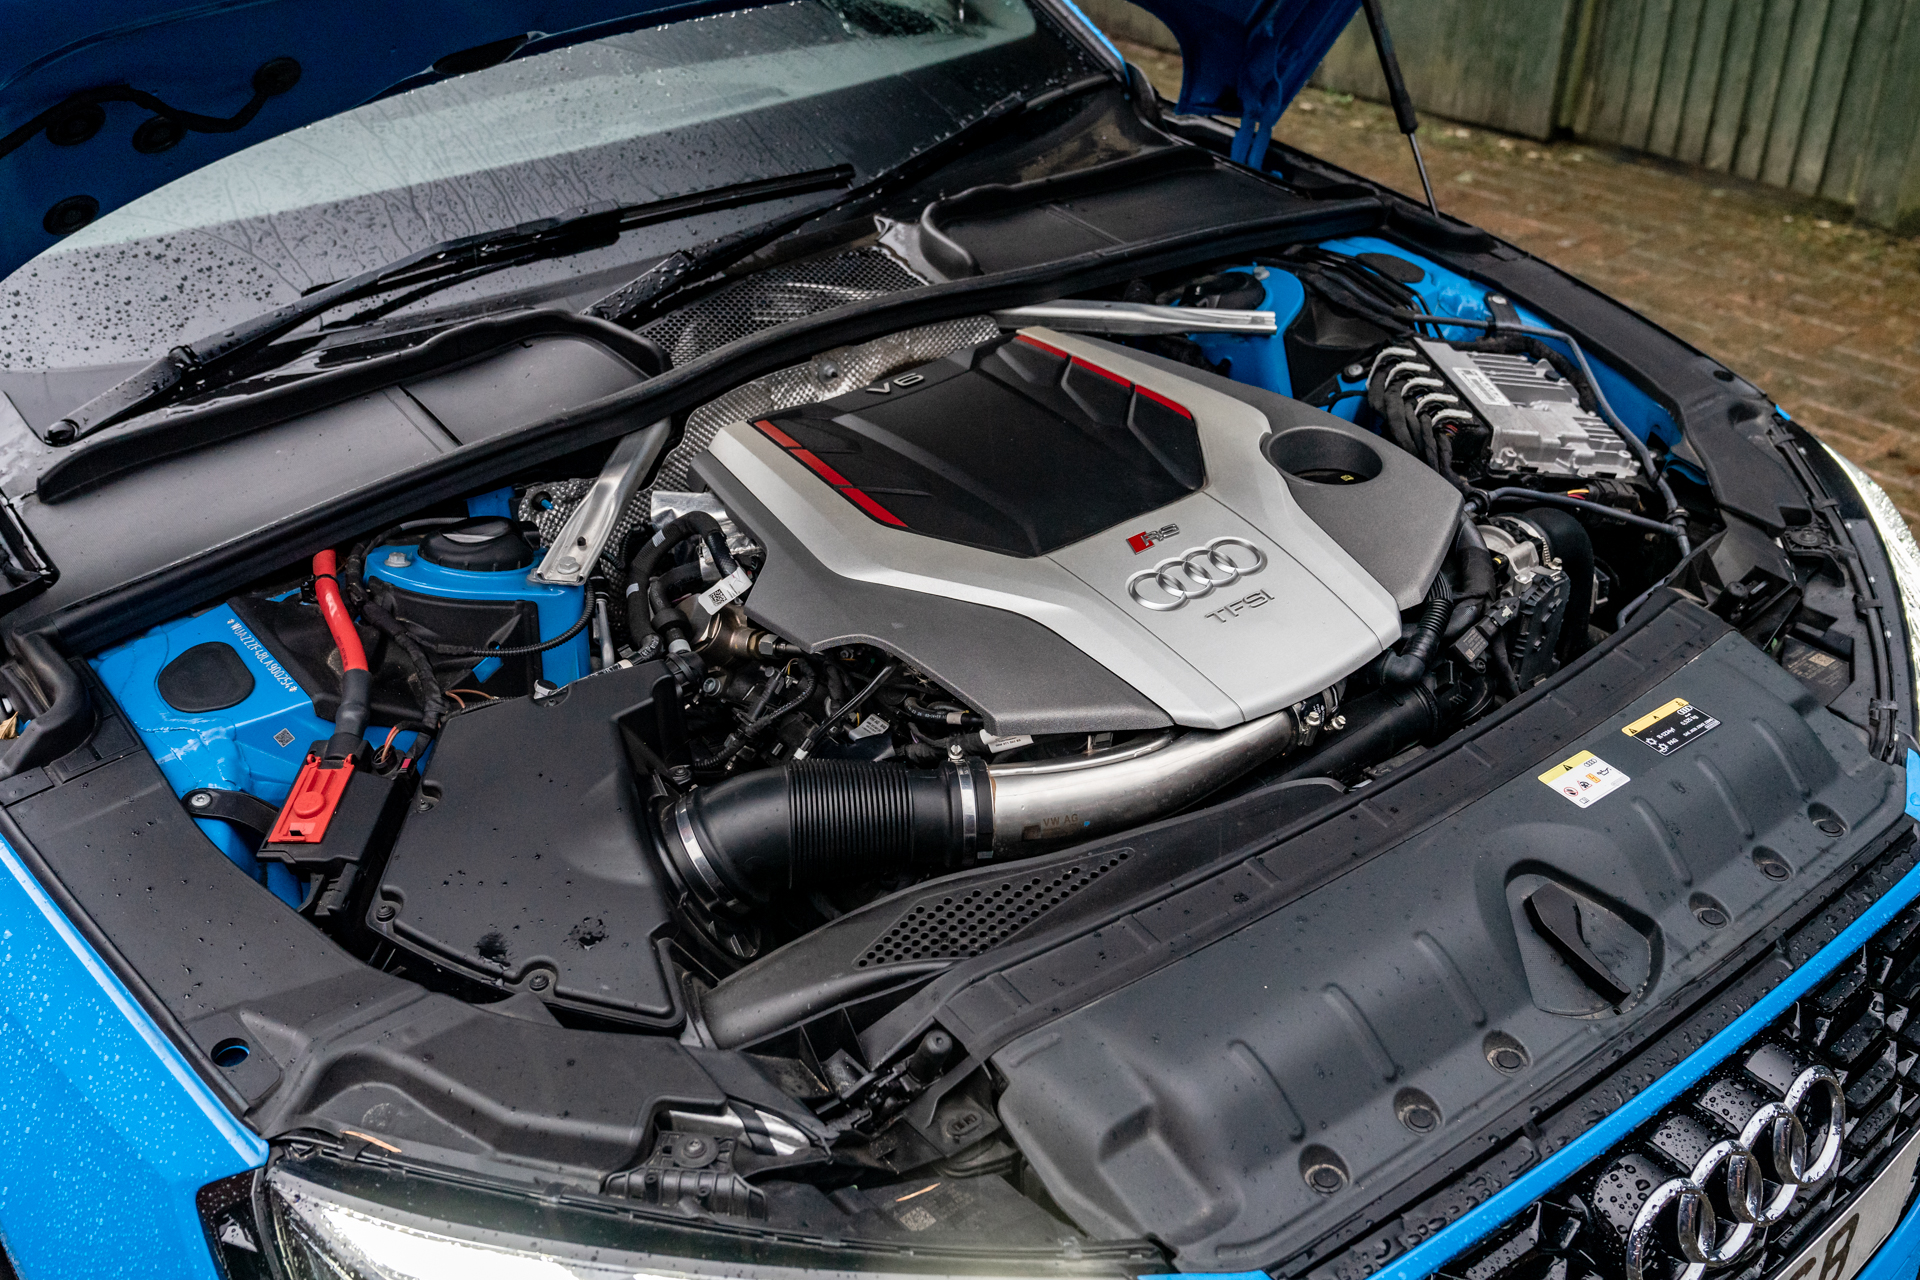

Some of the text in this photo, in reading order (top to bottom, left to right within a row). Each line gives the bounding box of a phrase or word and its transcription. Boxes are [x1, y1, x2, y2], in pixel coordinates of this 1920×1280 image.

[866, 373, 924, 393] V6
[1136, 522, 1180, 549] RS
[1205, 588, 1275, 623] TFSI
[1043, 814, 1079, 827] VW AG
